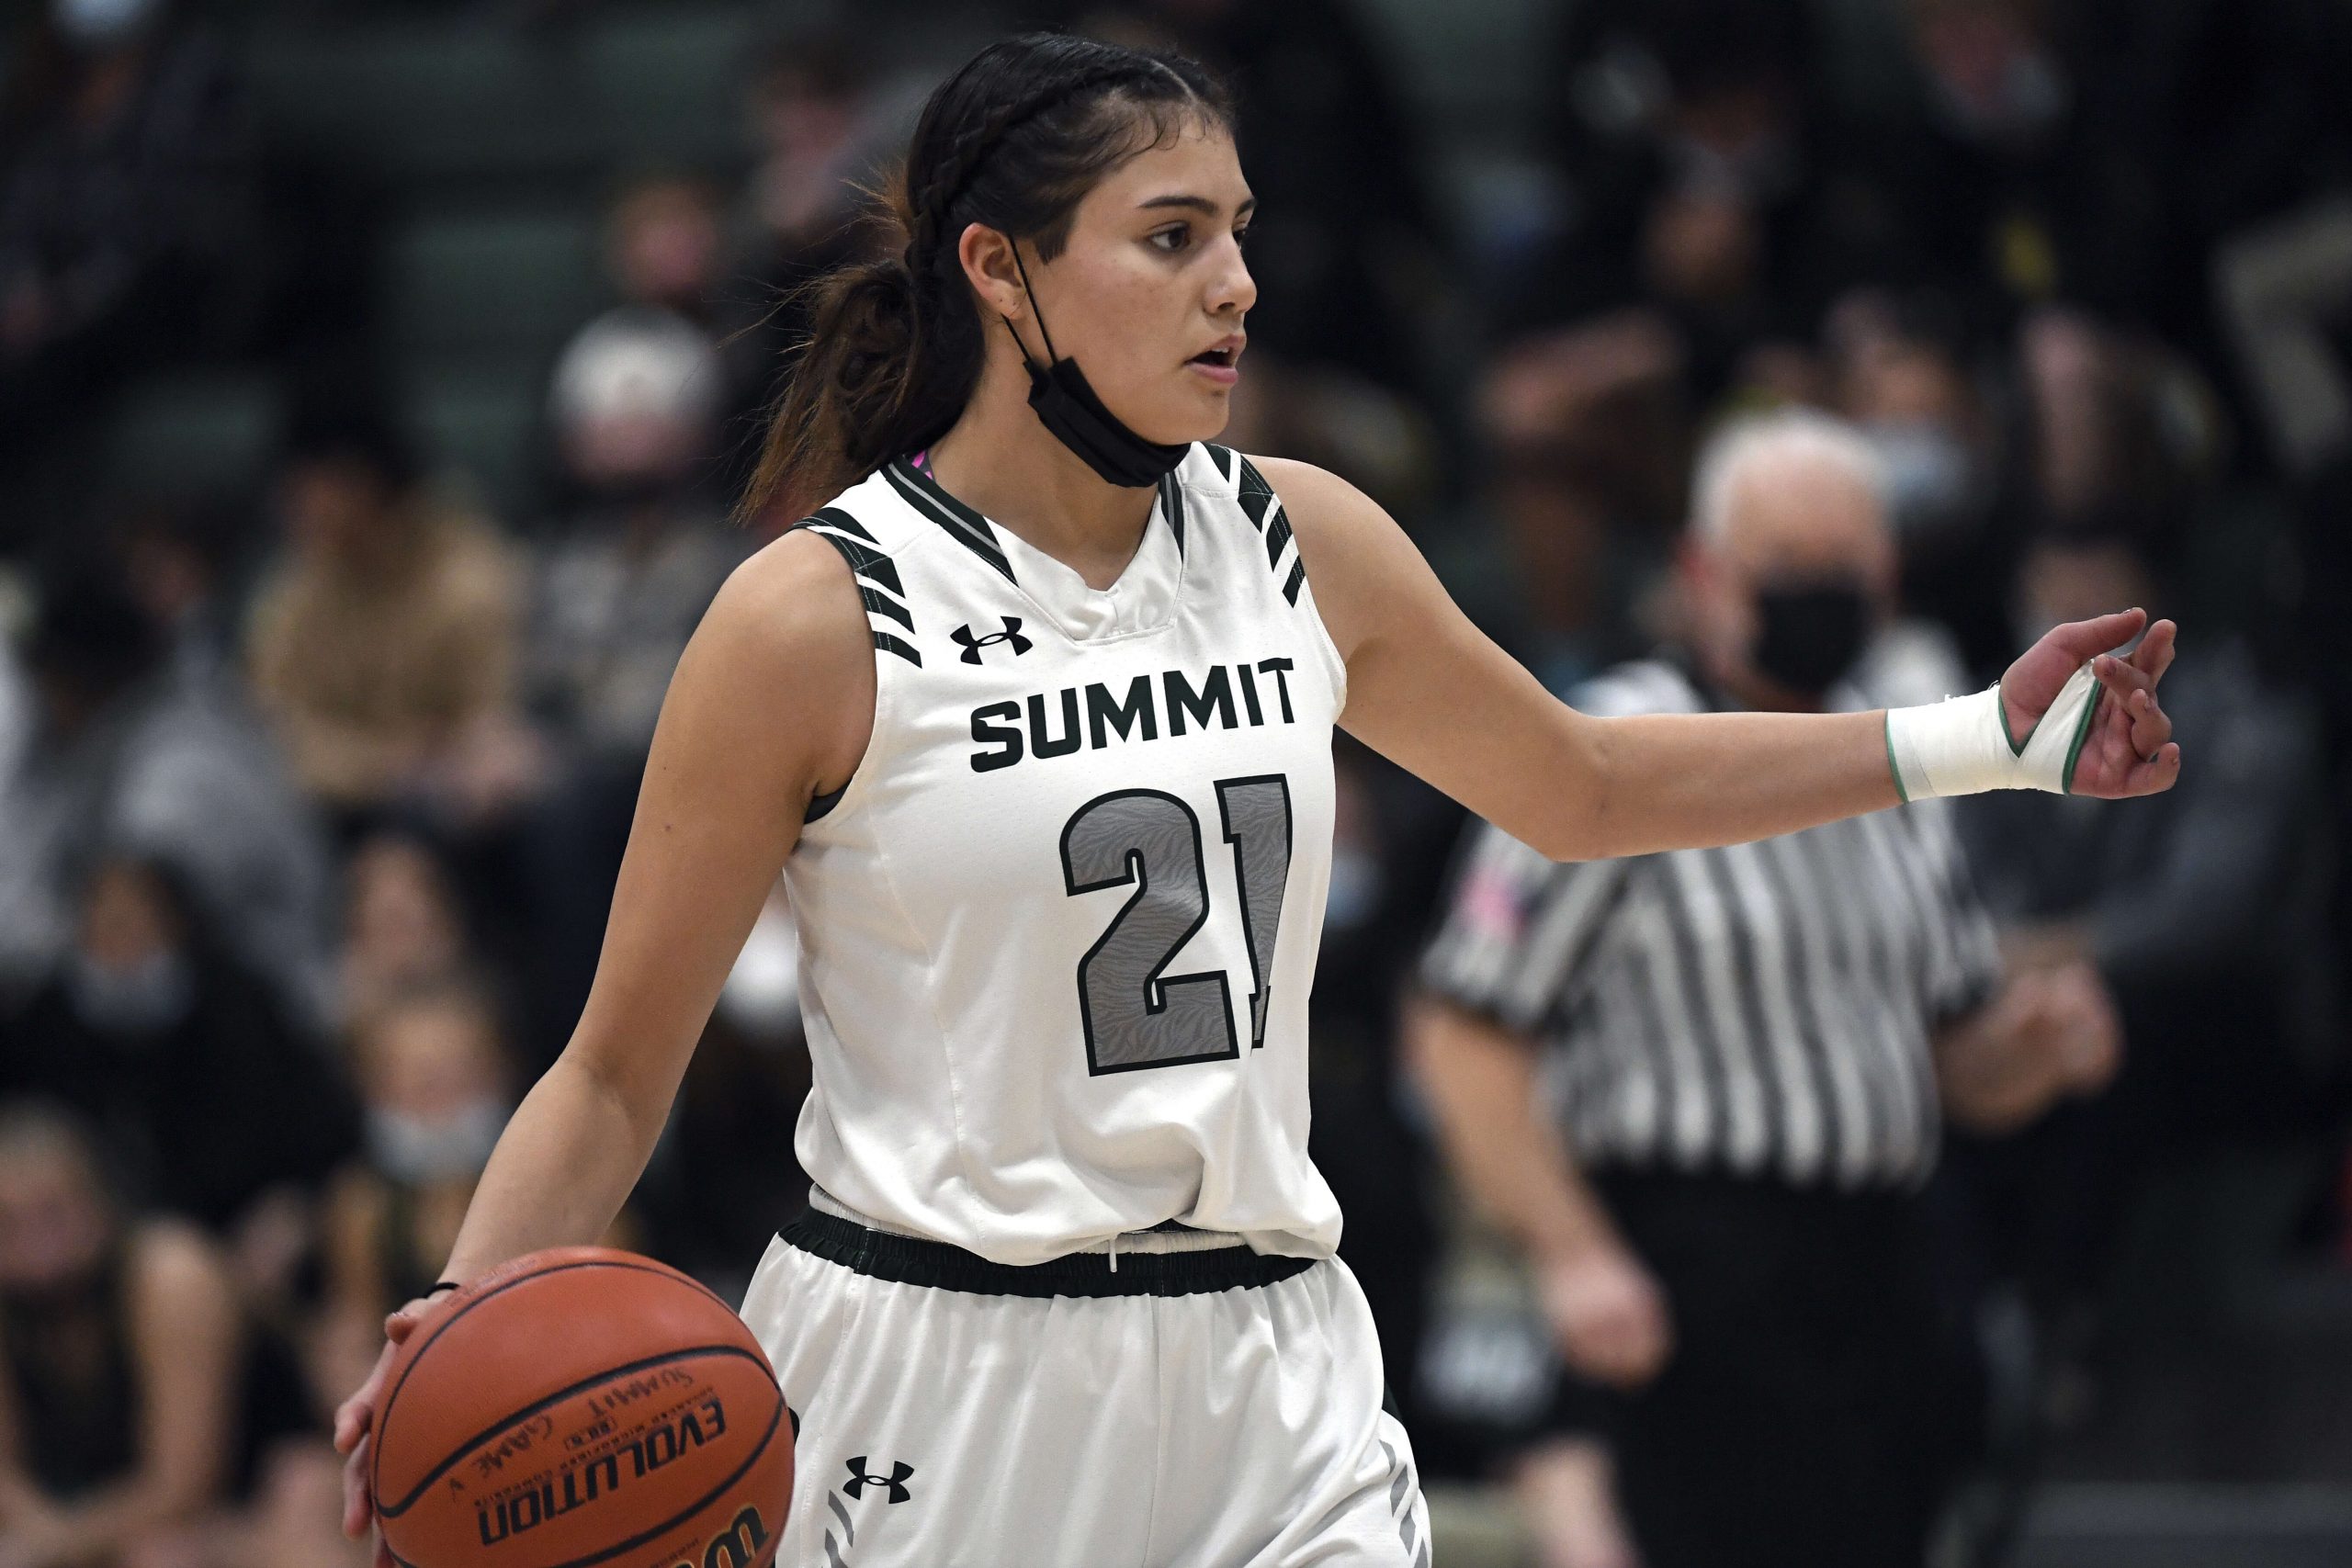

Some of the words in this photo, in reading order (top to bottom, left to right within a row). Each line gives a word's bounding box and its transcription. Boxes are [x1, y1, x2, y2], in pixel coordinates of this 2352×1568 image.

[970, 658, 1295, 773] SUMMIT
[1058, 773, 1294, 1077] 21
[471, 1417, 553, 1478] GAME
[588, 1367, 694, 1417] SUMMIT
[478, 1395, 727, 1547] EVOLUTION
